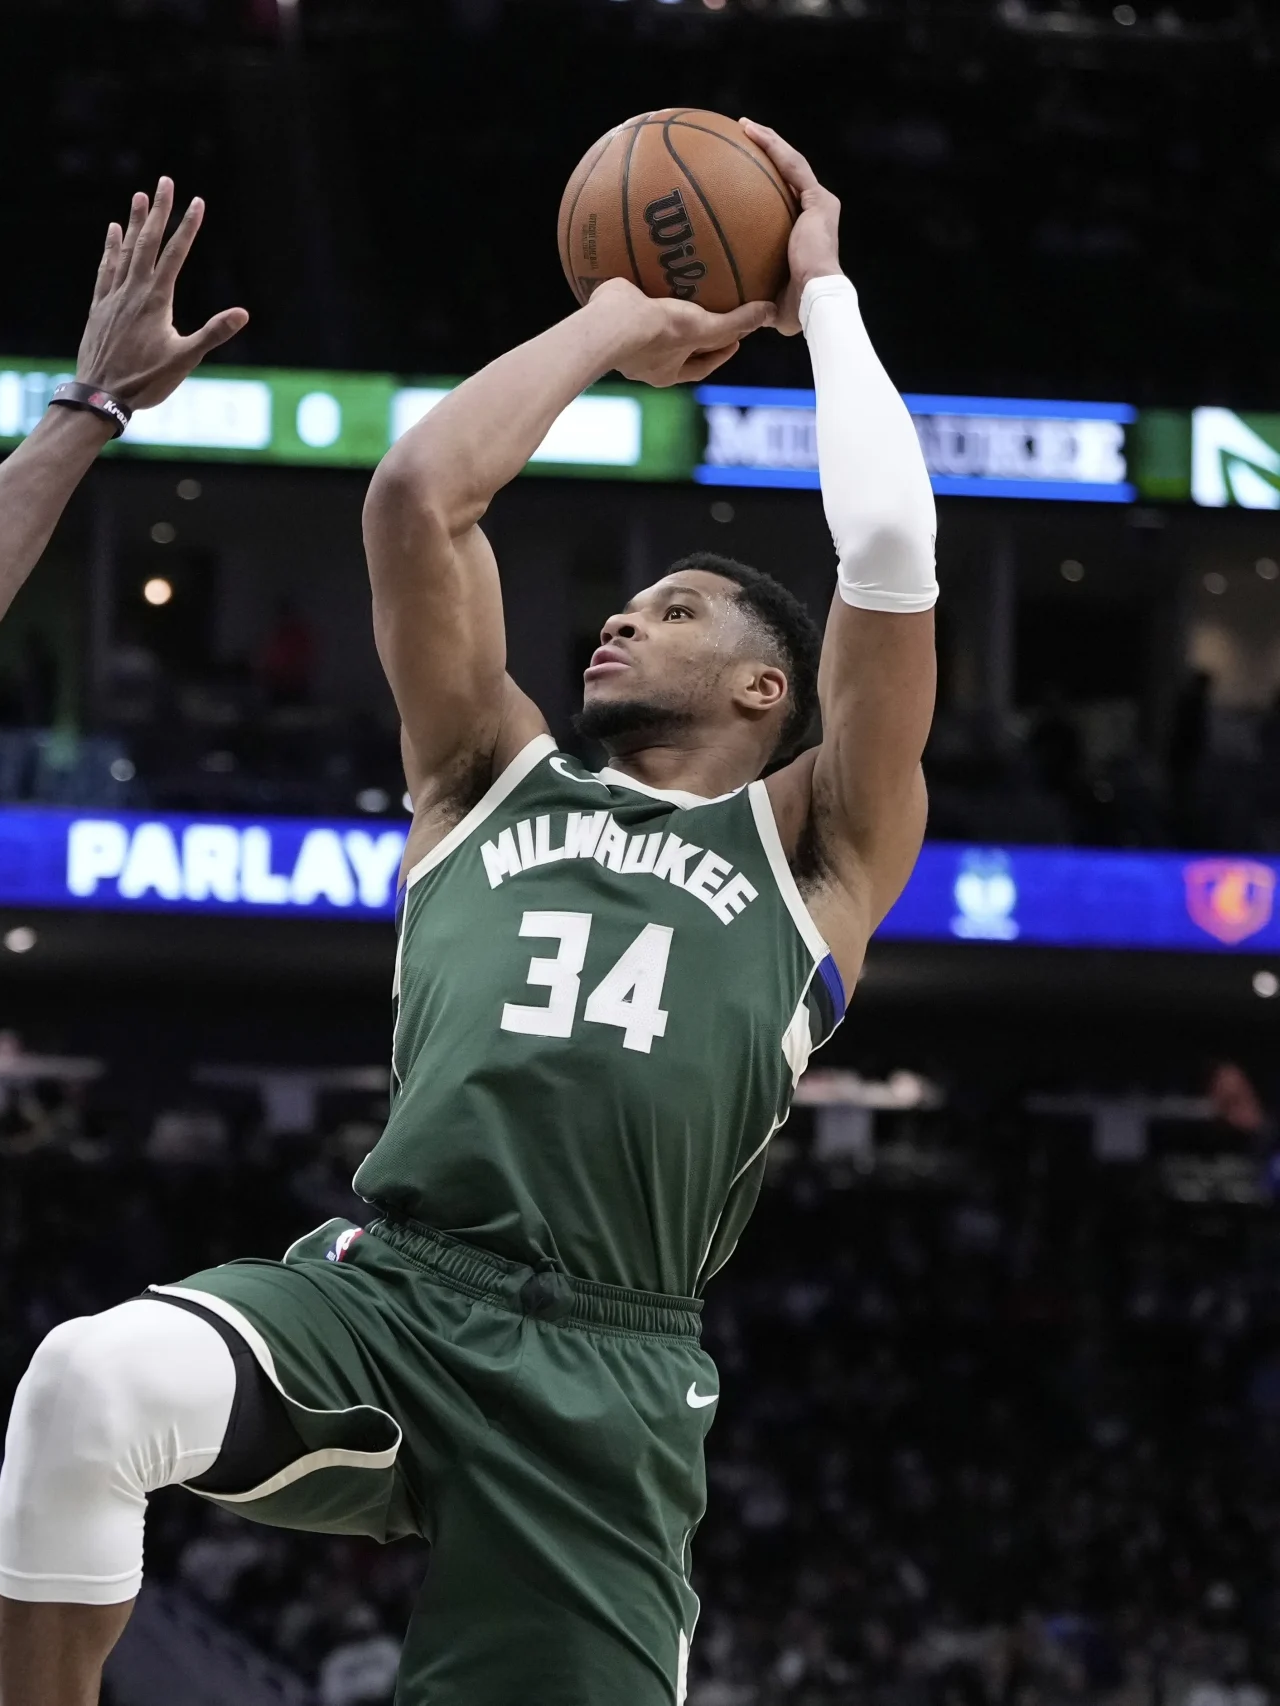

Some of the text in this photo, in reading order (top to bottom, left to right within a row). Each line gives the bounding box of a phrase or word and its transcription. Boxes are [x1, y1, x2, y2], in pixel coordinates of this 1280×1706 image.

[103, 400, 128, 429] Kraz
[296, 391, 341, 447] 0
[66, 820, 404, 908] PARLAY
[480, 811, 759, 926] MILWAUKEE
[500, 911, 674, 1054] 34
